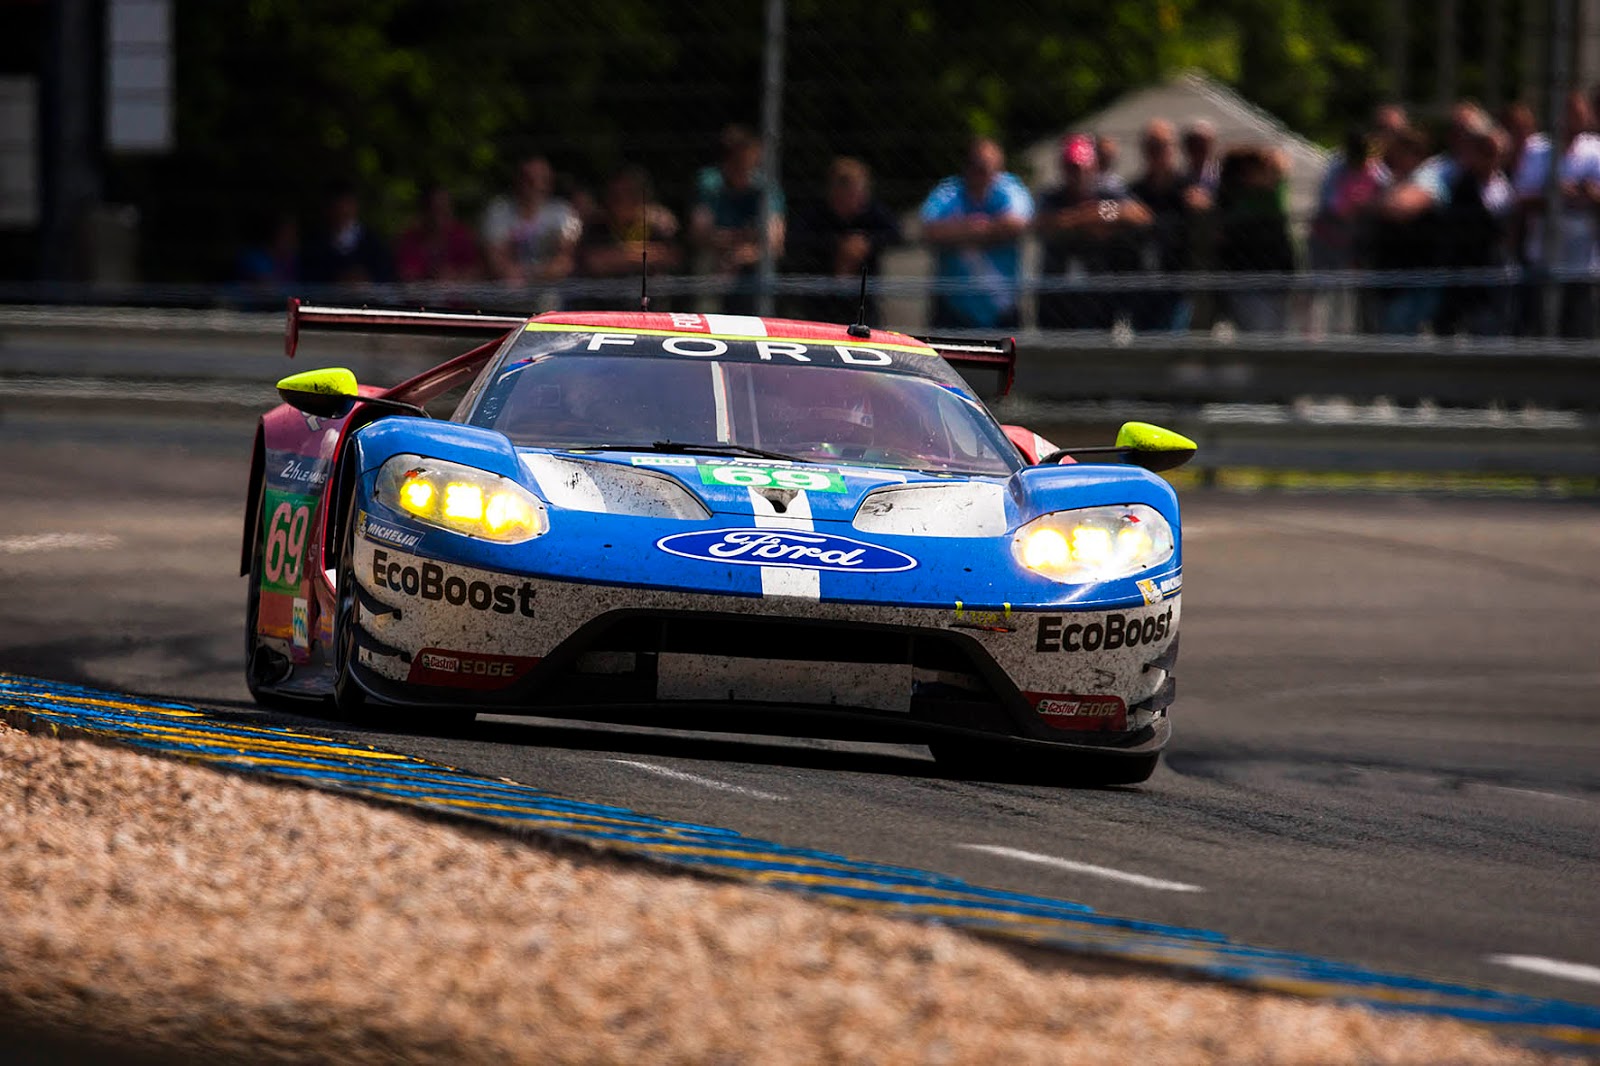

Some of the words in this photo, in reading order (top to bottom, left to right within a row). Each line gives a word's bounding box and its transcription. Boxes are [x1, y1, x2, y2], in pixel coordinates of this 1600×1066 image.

[586, 332, 893, 367] FORD
[712, 466, 832, 490] 69
[264, 501, 310, 587] 69
[366, 522, 420, 547] MICHELIN
[708, 530, 867, 567] Ford
[373, 549, 537, 618] EcoBoost
[1036, 604, 1174, 653] EcoBoost
[430, 656, 459, 672] Castrol
[461, 660, 516, 677] EDGE
[1078, 702, 1120, 717] EDGE
